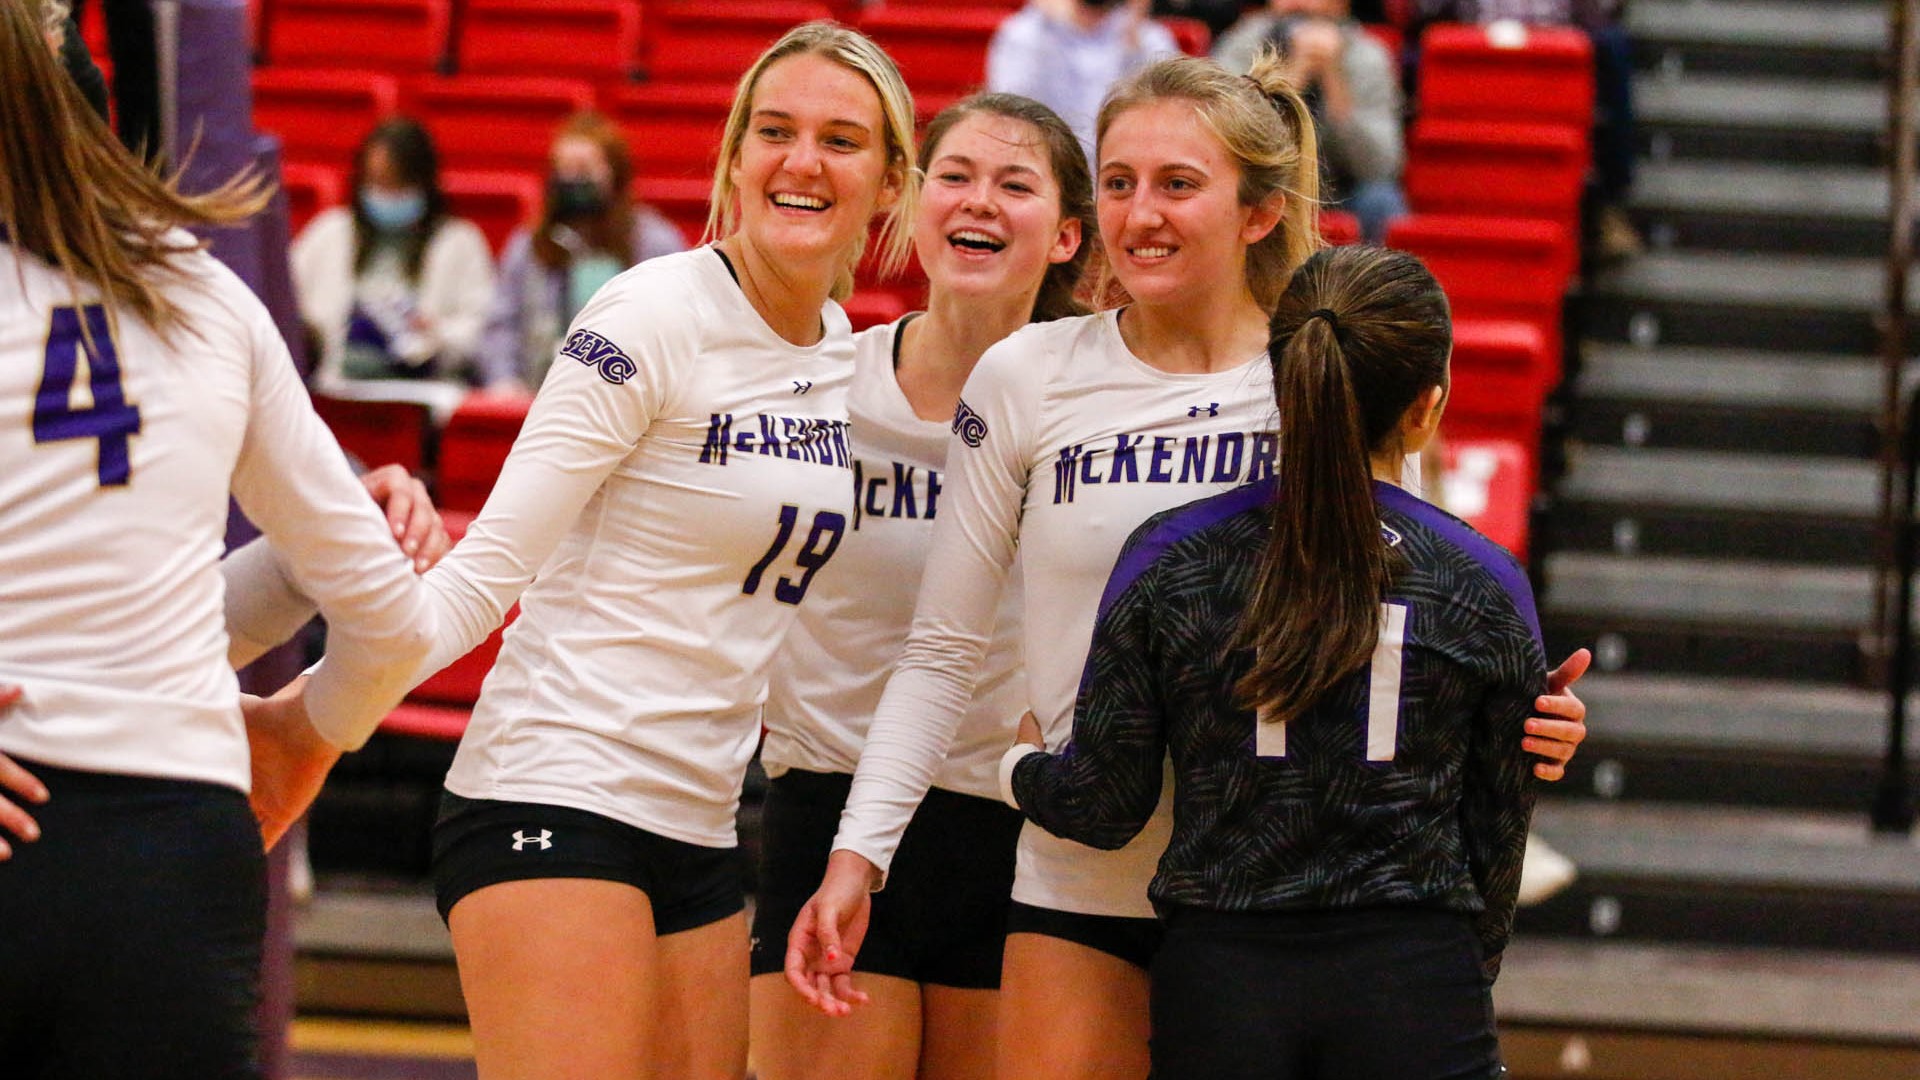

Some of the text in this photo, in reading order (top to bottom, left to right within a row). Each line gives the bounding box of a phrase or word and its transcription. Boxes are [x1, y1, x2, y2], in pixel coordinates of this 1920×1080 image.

[32, 303, 141, 487] 4
[699, 413, 853, 469] McKENDR
[742, 503, 846, 605] 19
